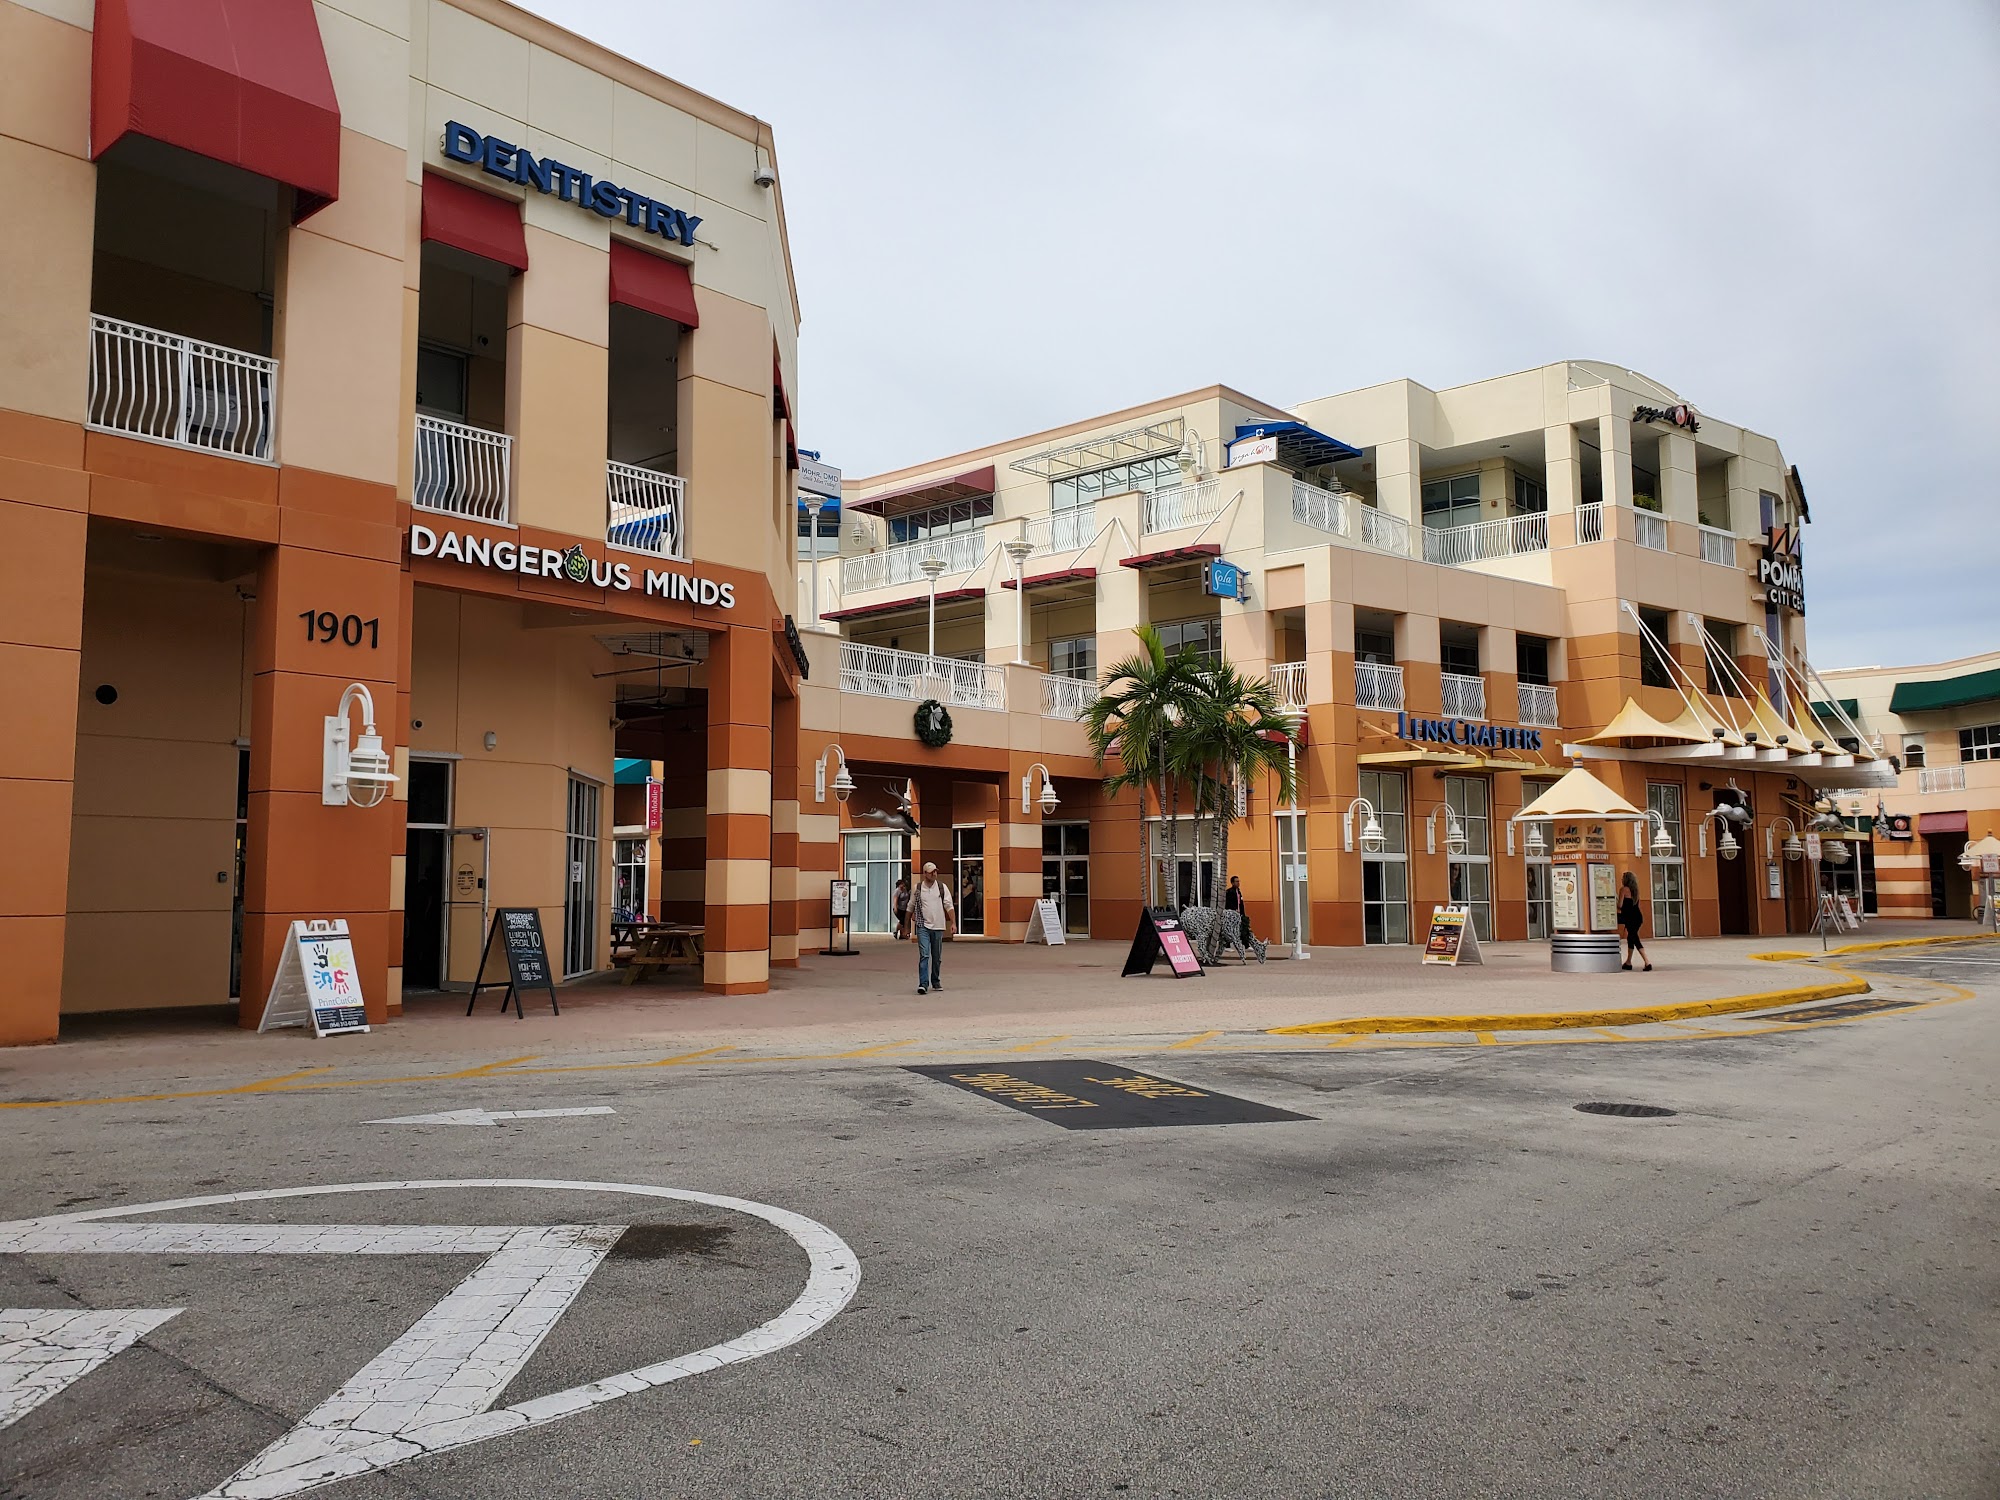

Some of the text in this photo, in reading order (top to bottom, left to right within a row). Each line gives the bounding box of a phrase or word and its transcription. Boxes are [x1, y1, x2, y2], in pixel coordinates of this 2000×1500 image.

[445, 120, 703, 247] DENTISTRY
[823, 472, 839, 483] DMD
[1760, 558, 1804, 596] POMPA
[644, 568, 736, 609] MINDS
[1770, 588, 1790, 606] CITI
[300, 609, 380, 650] 1901
[1556, 837, 1581, 845] POMPANO
[509, 931, 527, 939] LUNCH
[510, 938, 531, 947] SPECIAL
[1175, 945, 1181, 953] A
[318, 996, 358, 1007] PrintCutGo
